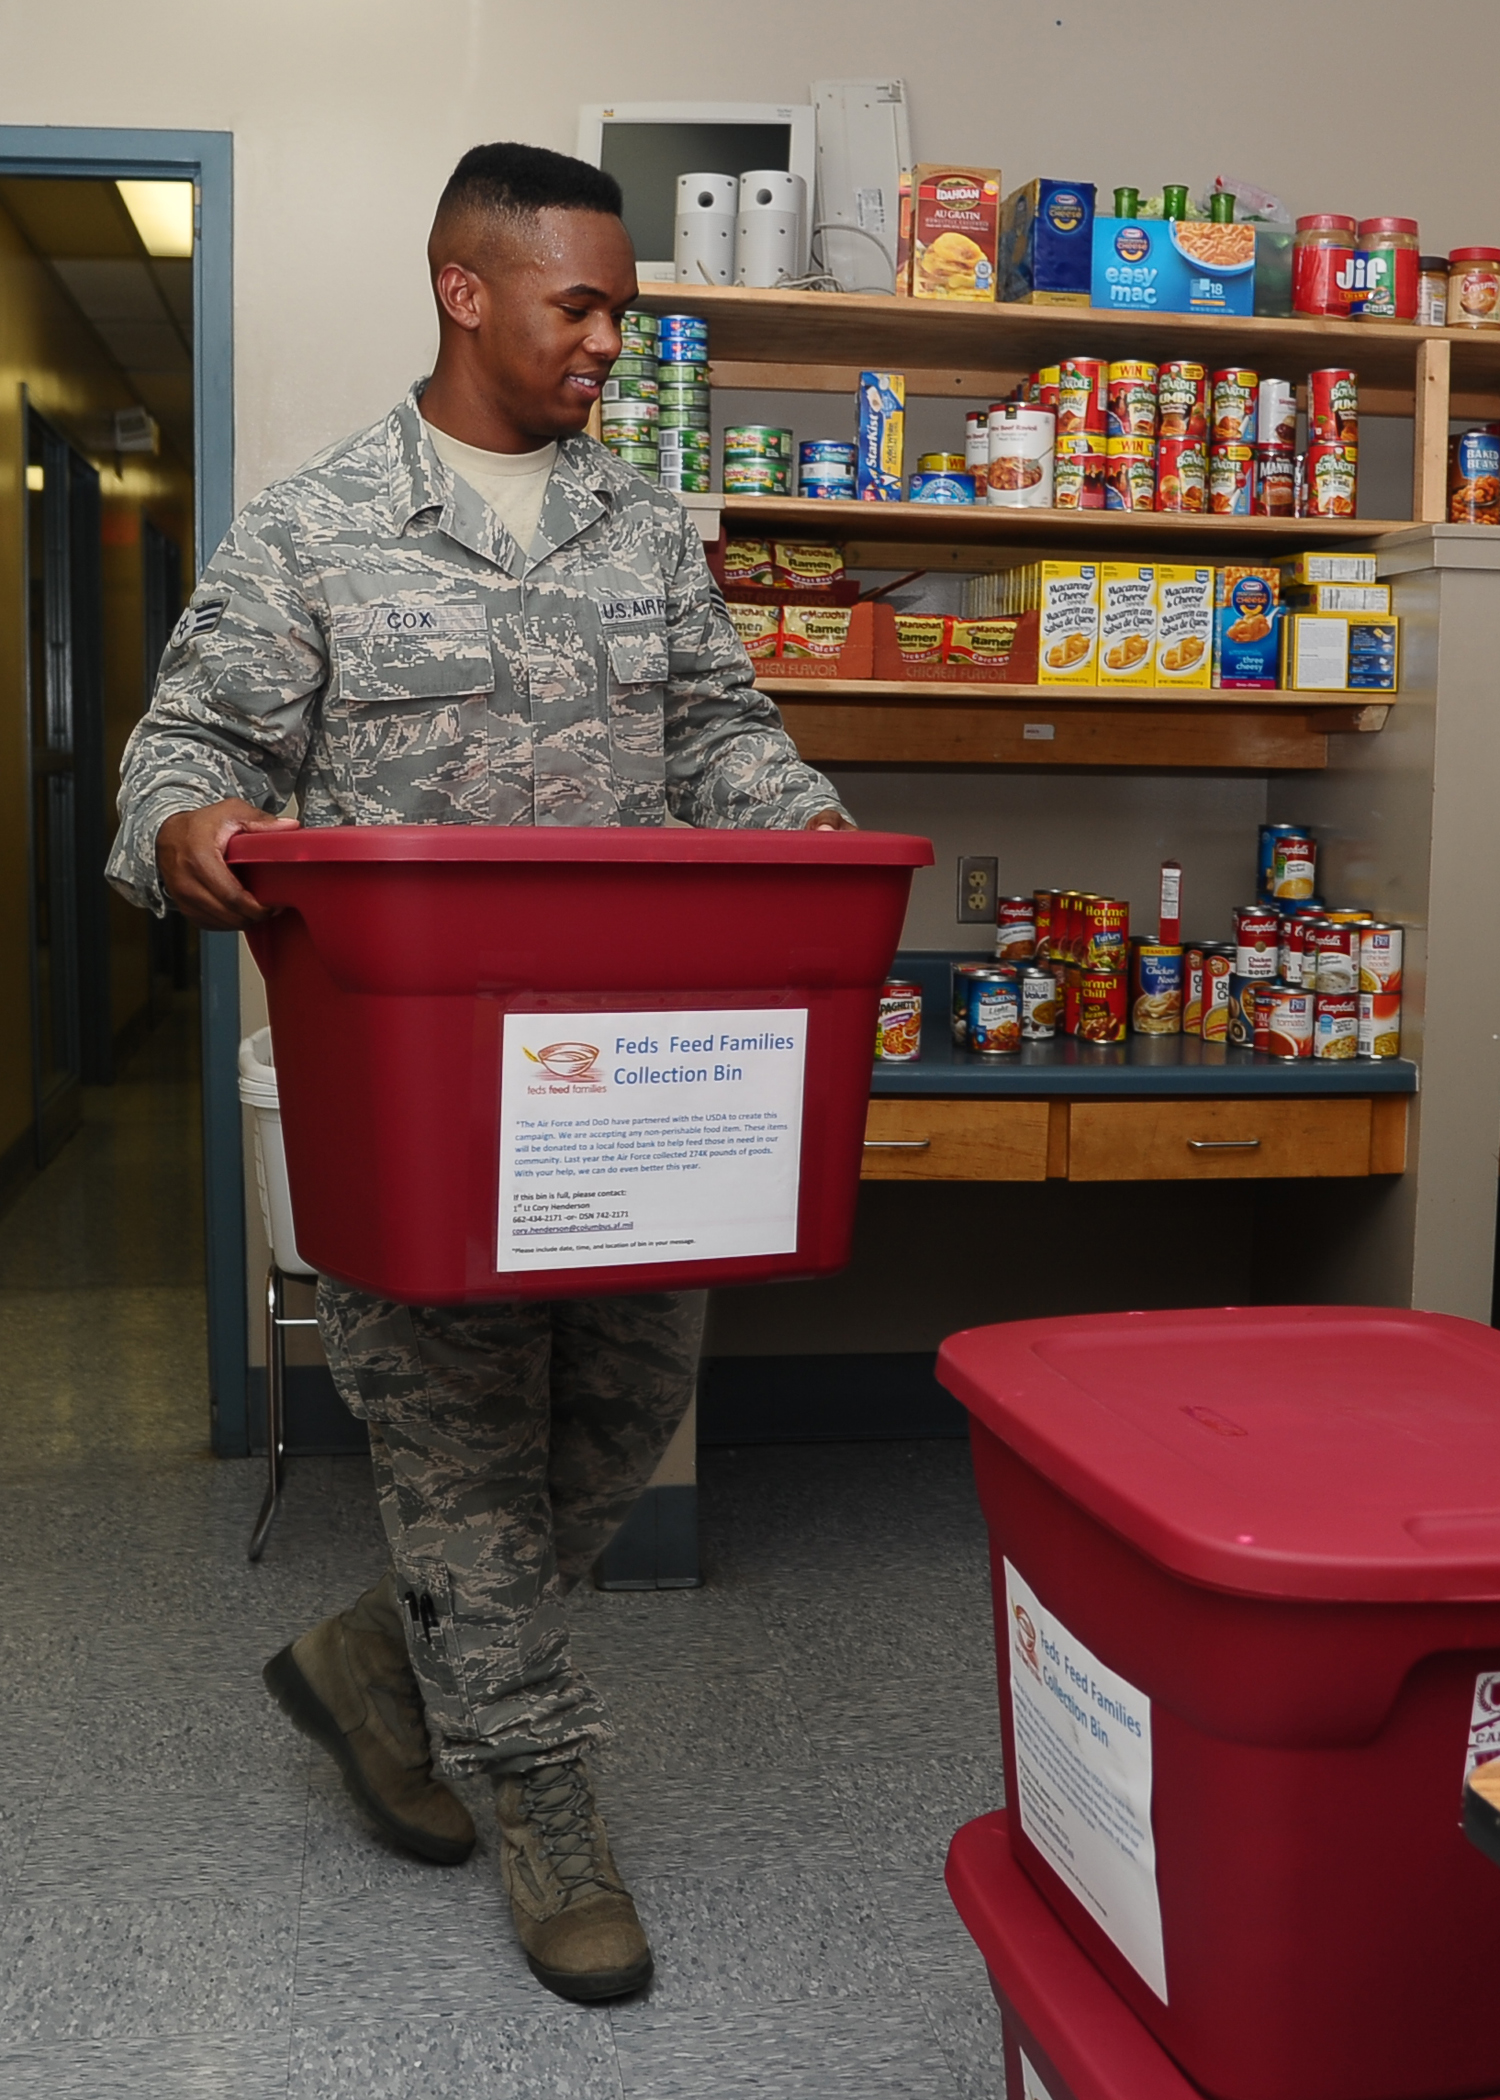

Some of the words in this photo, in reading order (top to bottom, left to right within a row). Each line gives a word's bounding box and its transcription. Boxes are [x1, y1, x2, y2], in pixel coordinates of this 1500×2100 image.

[936, 189, 980, 201] IDAHOAN
[934, 209, 948, 219] AU
[949, 210, 981, 221] GRATIN
[1105, 267, 1158, 287] easy
[1335, 257, 1388, 290] Jif
[1110, 285, 1158, 304] mac
[1210, 283, 1223, 296] 18
[1120, 365, 1142, 377] WIN
[866, 413, 880, 468] StarKist
[1121, 440, 1143, 451] WIN
[1466, 448, 1499, 461] BAKED
[1466, 459, 1499, 470] BEANS
[788, 558, 832, 569] Ramen
[1049, 582, 1093, 595] Macaroni
[1108, 584, 1151, 597] Macaroni
[1165, 585, 1207, 599] Macaroni
[1058, 592, 1089, 603] Cheese
[1117, 593, 1148, 604] Cheese
[1173, 596, 1204, 606] Cheese
[603, 602, 632, 619] U.S.
[632, 599, 657, 617] AIR
[387, 611, 433, 629] COX
[896, 632, 938, 642] Ramen
[1242, 656, 1264, 665] three
[788, 663, 838, 676] FLAVOR
[905, 666, 957, 679] CHICKEN
[960, 667, 1007, 680] FLAVOR
[1235, 663, 1264, 672] cheesy
[1086, 906, 1128, 917] Hormel
[1094, 916, 1120, 927] Chili
[1094, 934, 1122, 944] Turkey
[1146, 966, 1175, 975] Chicken
[1082, 979, 1117, 989] ormel
[1025, 991, 1048, 1000] Value
[1083, 988, 1107, 999] Chili
[615, 1036, 659, 1055] Feds
[670, 1034, 714, 1053] Feed
[720, 1032, 794, 1051] Families
[613, 1065, 708, 1085] Collection
[713, 1063, 743, 1082] Bin
[527, 1086, 547, 1095] feds
[549, 1085, 570, 1094] feed
[572, 1083, 607, 1094] families
[537, 1120, 549, 1128] Air
[551, 1119, 573, 1128] Force
[575, 1118, 590, 1127] and
[611, 1117, 630, 1126] have
[632, 1116, 670, 1127] partnered
[672, 1114, 689, 1123] with
[691, 1114, 704, 1122] the
[705, 1113, 727, 1122] USDA
[763, 1112, 778, 1120] this
[515, 1132, 556, 1141] campaign.
[558, 1131, 572, 1140] We
[589, 1129, 627, 1139] accepting
[628, 1130, 642, 1138] any
[644, 1126, 701, 1137] non-perishable
[703, 1125, 721, 1134] food
[722, 1125, 741, 1133] item.
[744, 1124, 765, 1132] These
[767, 1123, 788, 1131] items
[515, 1144, 529, 1153] will
[531, 1144, 541, 1152] be
[543, 1143, 577, 1152] donated
[596, 1142, 615, 1150] local
[616, 1141, 634, 1150] food
[636, 1140, 655, 1149] bank
[667, 1138, 684, 1148] help
[686, 1138, 703, 1146] feed
[704, 1137, 725, 1145] those
[736, 1135, 755, 1144] need
[514, 1156, 562, 1166] community.
[582, 1156, 599, 1164] year
[601, 1154, 615, 1162] the
[616, 1153, 628, 1161] Air
[630, 1153, 651, 1161] Force
[652, 1150, 687, 1160] collected
[709, 1148, 737, 1158] pounds
[748, 1147, 773, 1156] goods.
[514, 1169, 534, 1177] With
[535, 1169, 554, 1178] your
[555, 1168, 576, 1176] help,
[640, 1163, 664, 1172] better
[666, 1163, 680, 1171] this
[682, 1162, 701, 1171] year.
[520, 1193, 534, 1201] this
[556, 1191, 571, 1200] full,
[572, 1190, 596, 1200] please
[597, 1190, 627, 1198] contact:
[532, 1204, 549, 1212] Cory
[551, 1202, 591, 1211] Henderson
[579, 1212, 594, 1220] DSN
[1040, 1628, 1061, 1666] Feds
[1064, 1655, 1089, 1695] Feed
[1090, 1679, 1142, 1738] Families
[1042, 1664, 1088, 1729] Collection
[1089, 1714, 1109, 1748] Bin
